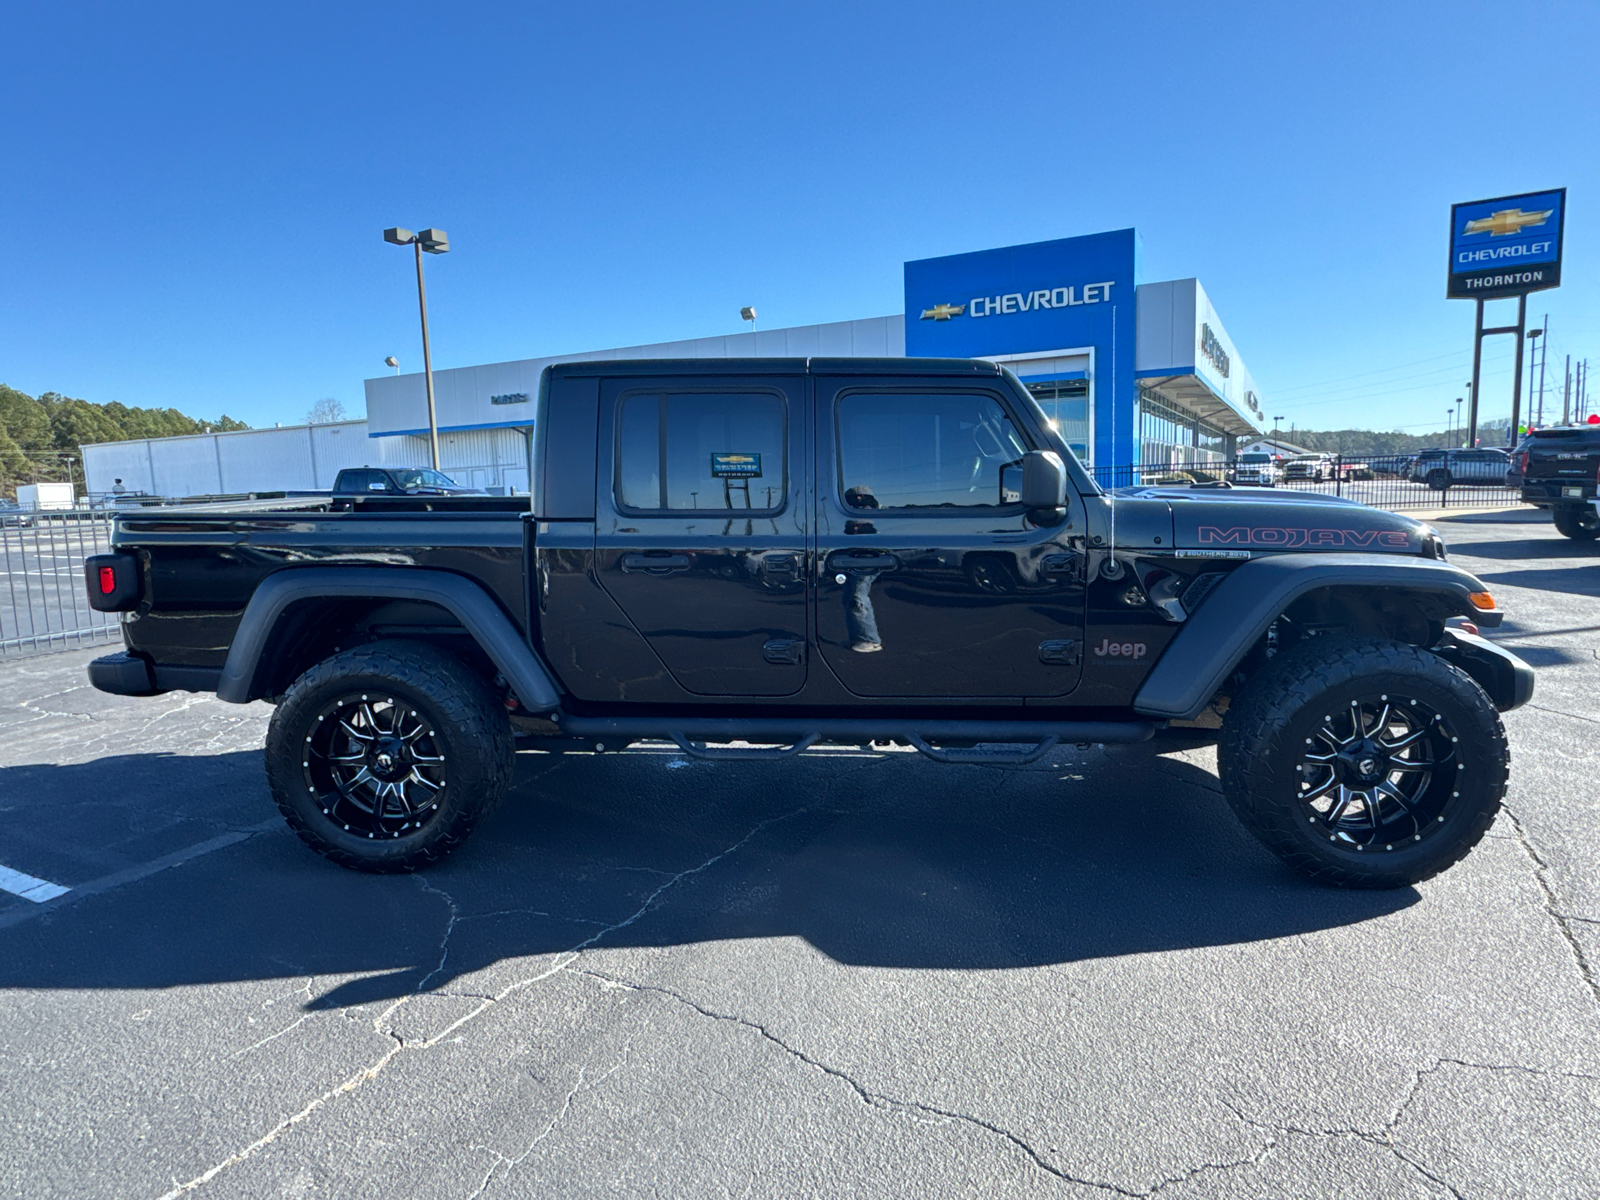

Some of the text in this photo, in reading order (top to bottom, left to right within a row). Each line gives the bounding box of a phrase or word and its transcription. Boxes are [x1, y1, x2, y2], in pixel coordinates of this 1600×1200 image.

[1459, 242, 1551, 262] CHEVROLET
[1465, 271, 1542, 289] THORNTON
[970, 281, 1115, 317] CHEVROLET
[1198, 527, 1409, 547] MOJAVE
[1094, 639, 1147, 659] Jeep
